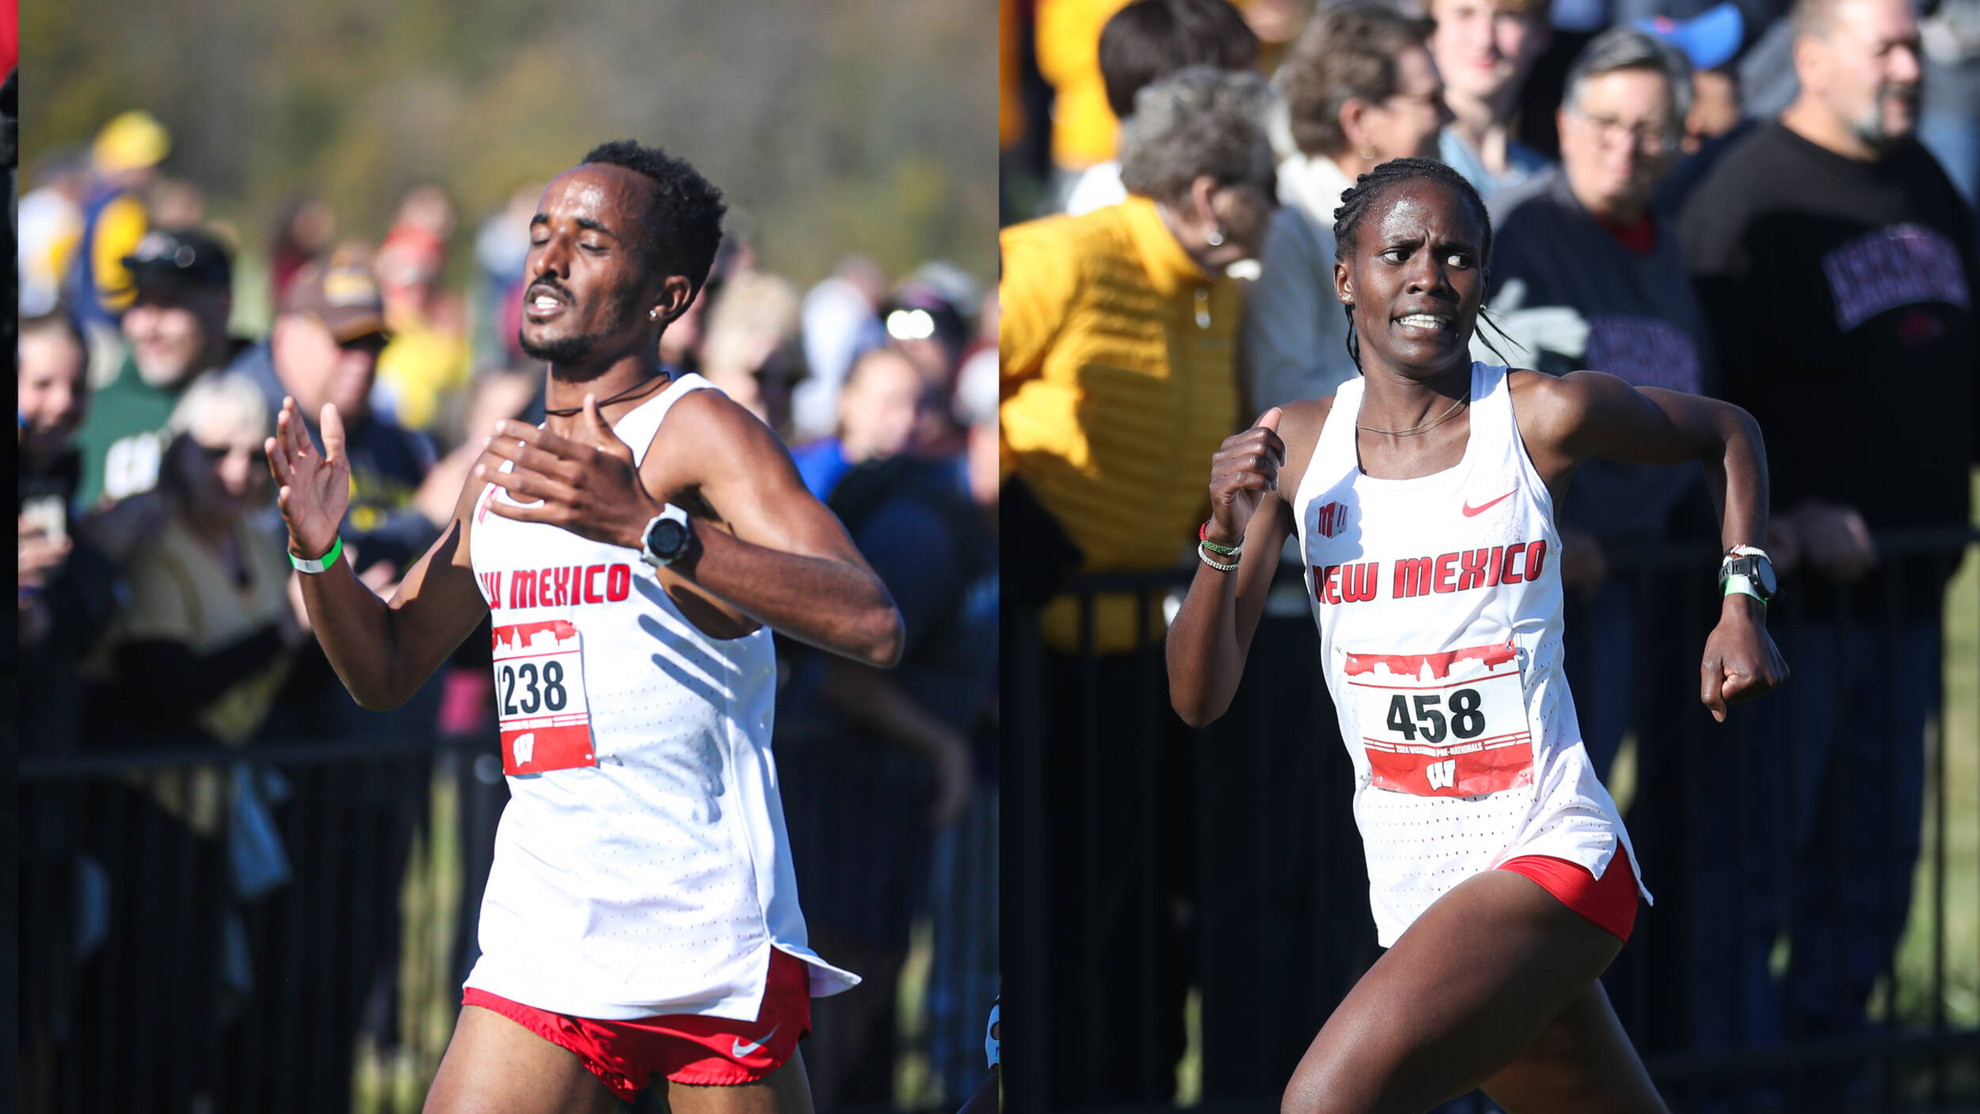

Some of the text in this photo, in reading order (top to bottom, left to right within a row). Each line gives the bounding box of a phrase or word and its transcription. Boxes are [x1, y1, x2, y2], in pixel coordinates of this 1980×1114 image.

[509, 563, 630, 609] MEXICO
[1312, 539, 1547, 605] NEW MEXICO
[1386, 688, 1486, 743] 458
[1426, 759, 1456, 791] W
